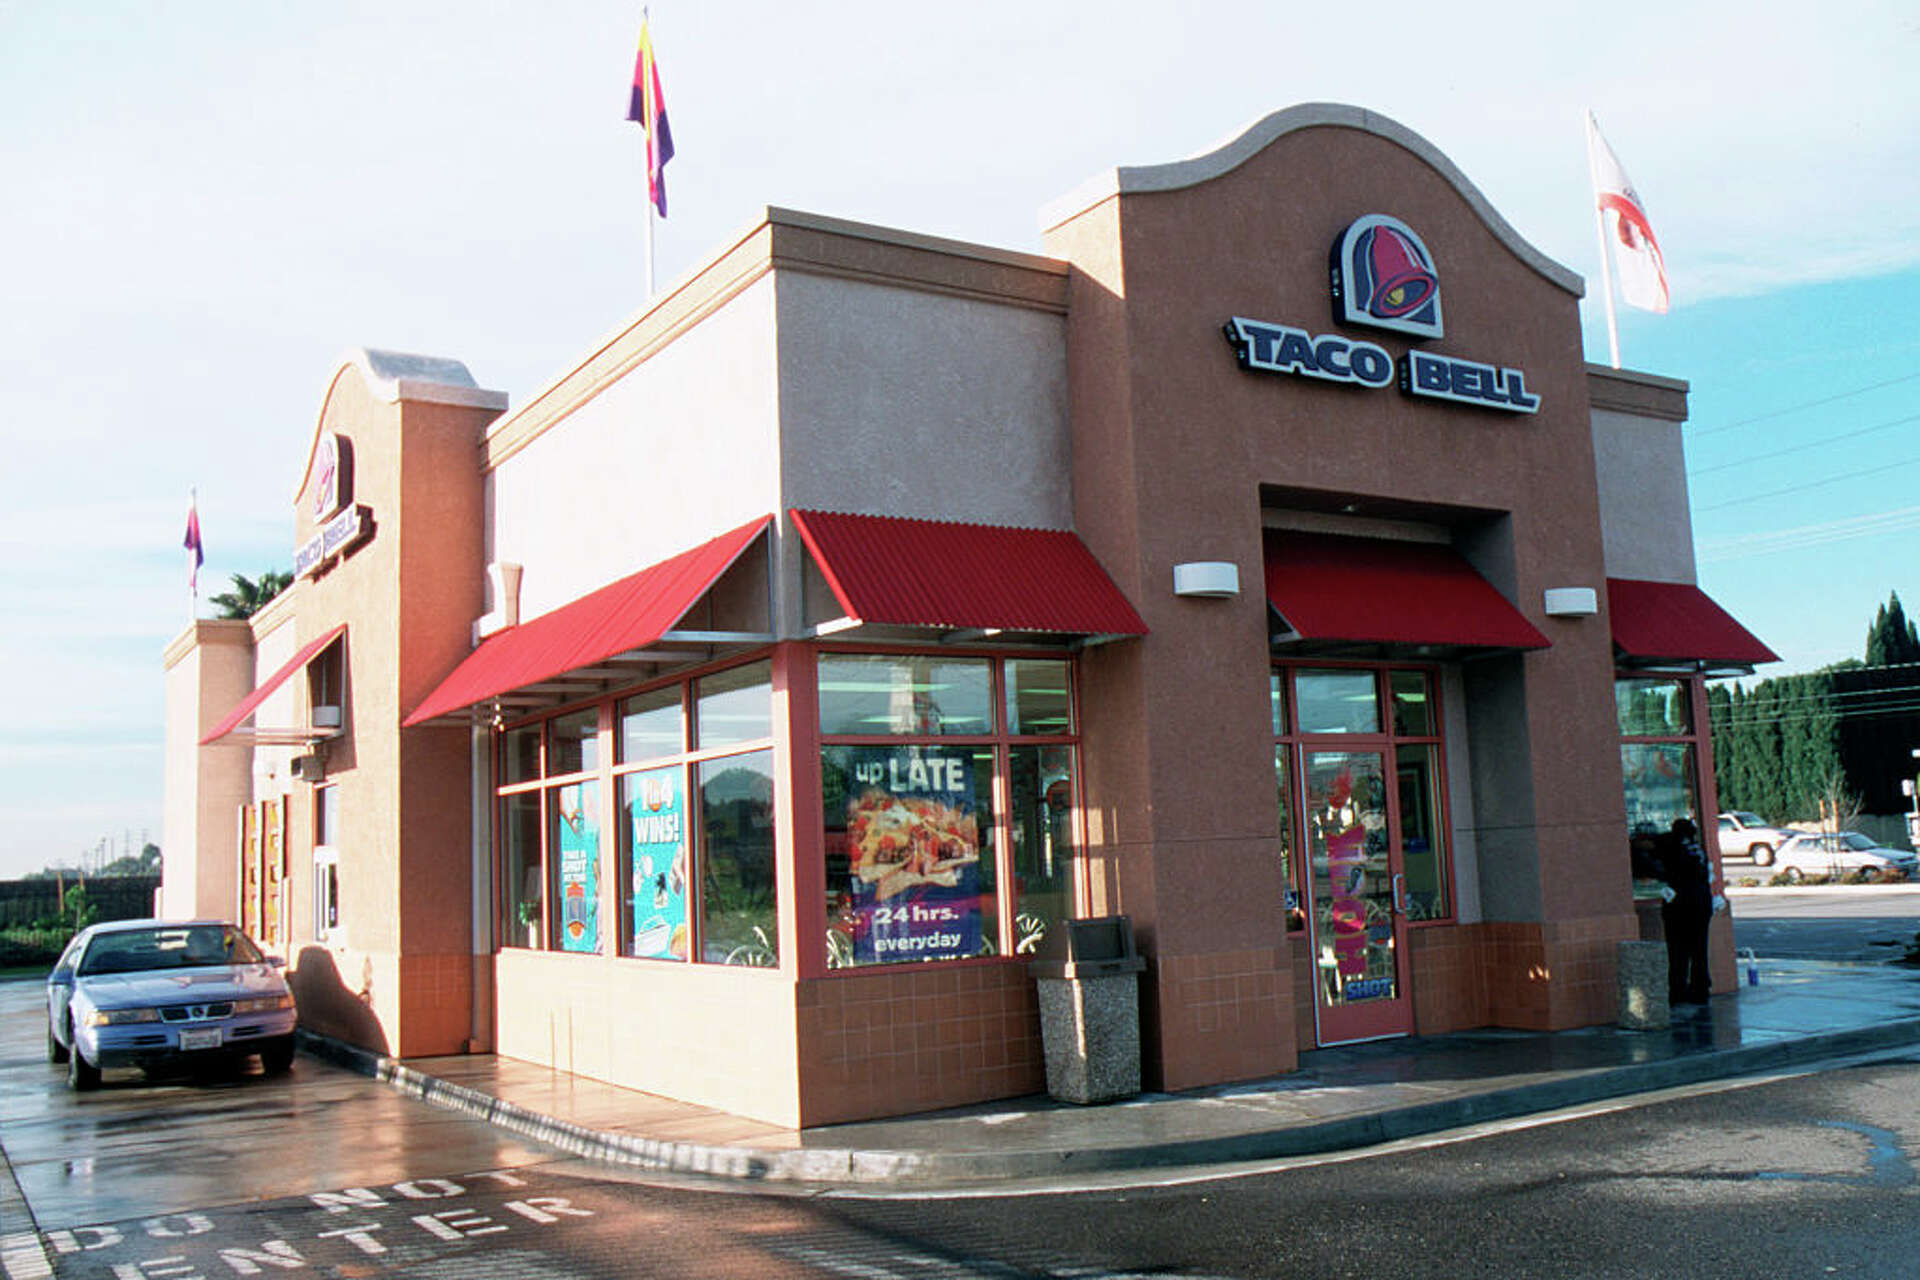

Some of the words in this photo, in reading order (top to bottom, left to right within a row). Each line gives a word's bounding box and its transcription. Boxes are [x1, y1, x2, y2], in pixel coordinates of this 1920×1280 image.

[1240, 322, 1392, 384] TACO
[1413, 354, 1538, 408] BELL
[855, 761, 884, 785] up
[889, 757, 966, 792] LATE
[634, 812, 679, 844] WINS!
[875, 906, 909, 924] 24
[913, 904, 960, 922] hrs.
[874, 931, 961, 952] everyday
[1346, 977, 1394, 999] SHOT
[47, 1214, 215, 1254] DO
[308, 1168, 527, 1213] NOT
[109, 1197, 596, 1280] ENTER
